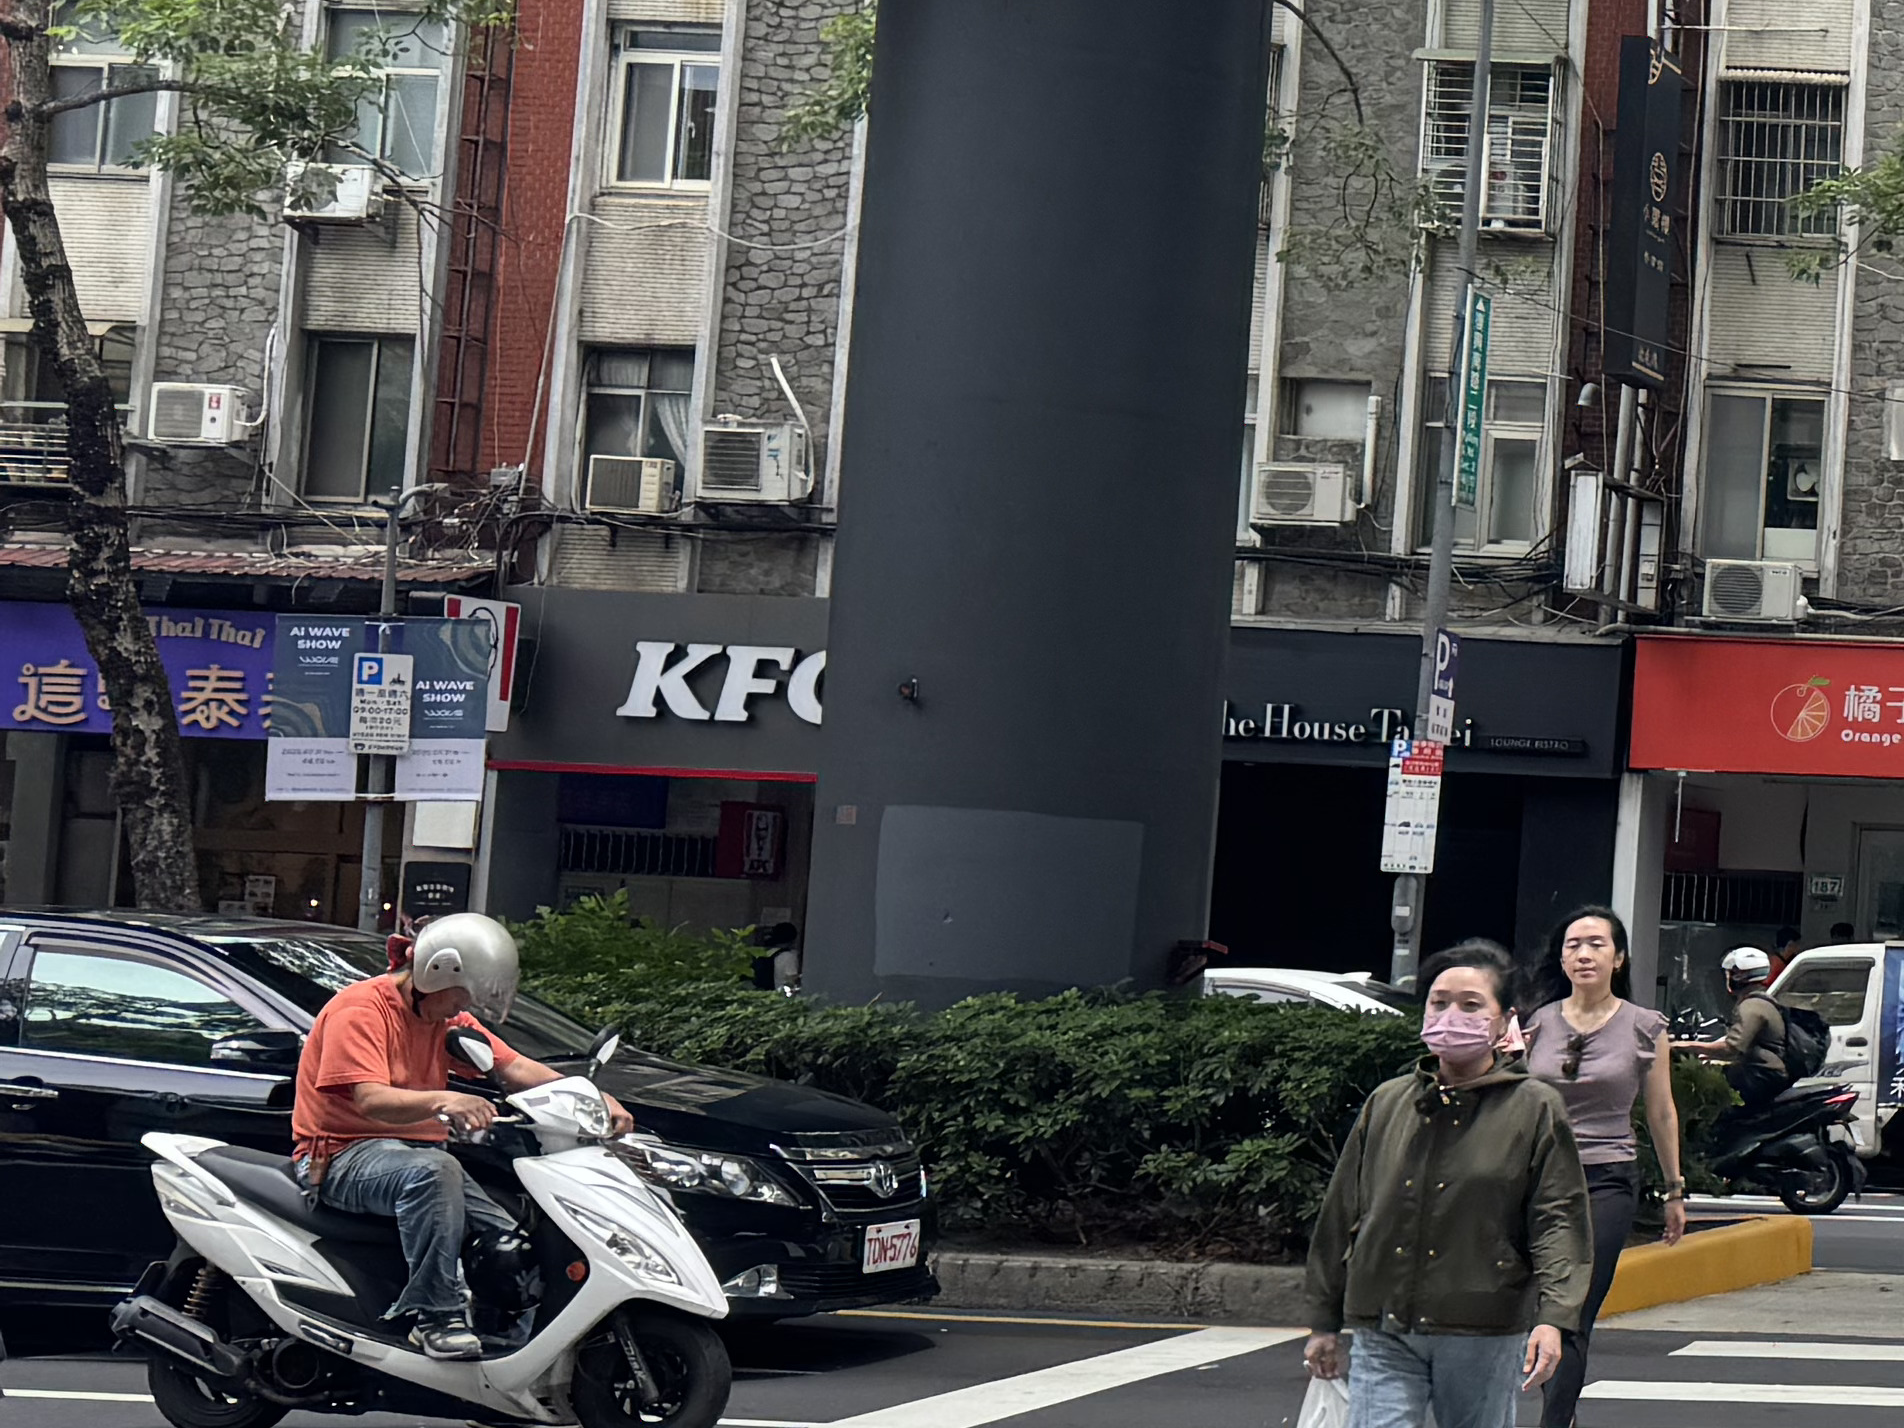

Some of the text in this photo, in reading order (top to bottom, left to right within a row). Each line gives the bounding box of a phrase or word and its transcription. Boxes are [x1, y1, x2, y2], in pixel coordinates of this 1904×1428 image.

[289, 626, 350, 638] AI WAVE
[297, 639, 342, 650] SHOW
[361, 660, 380, 682] P
[415, 680, 475, 691] AI WAVE
[422, 692, 466, 703] SHOW
[1263, 703, 1367, 743] House
[1370, 708, 1474, 748] Taei
[1840, 729, 1902, 747] Orange
